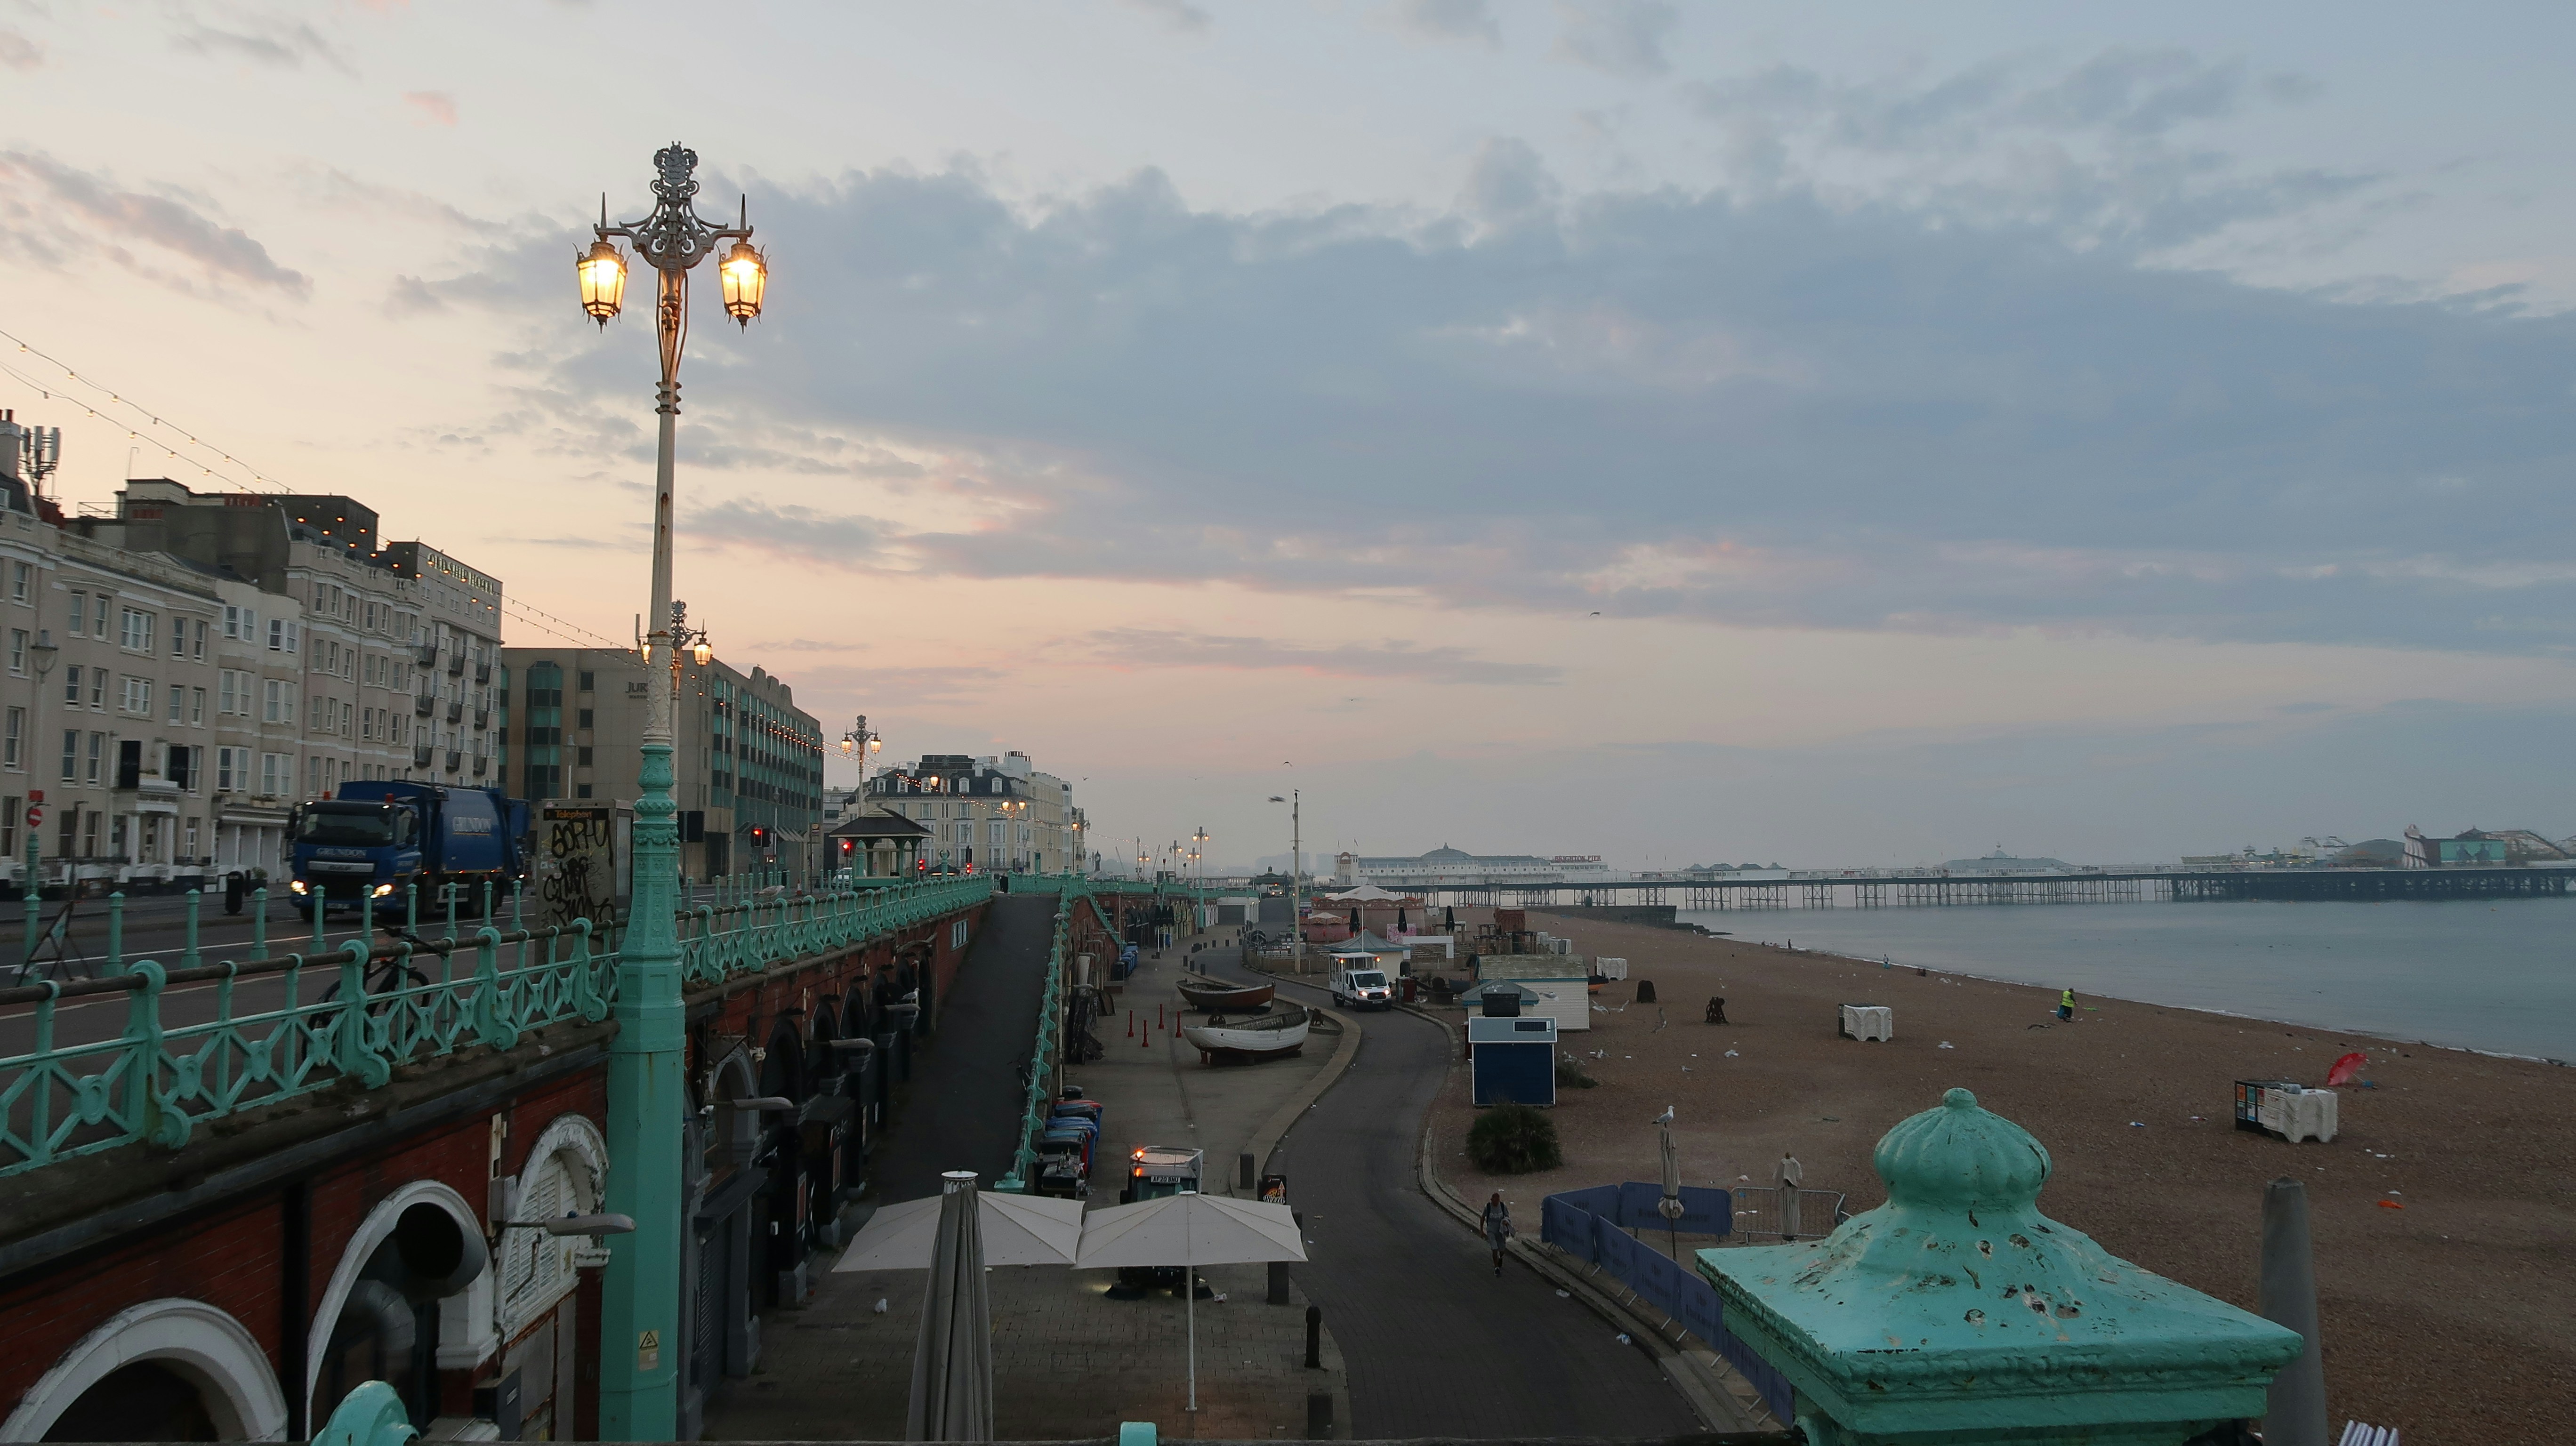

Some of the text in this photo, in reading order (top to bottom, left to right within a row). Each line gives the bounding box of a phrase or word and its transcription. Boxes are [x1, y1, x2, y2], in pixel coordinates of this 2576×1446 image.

[428, 553, 495, 595] OLD SHIP HOTEL
[625, 682, 648, 693] JUR
[555, 810, 593, 819] Telephon
[1263, 1194, 1286, 1205] Pizza
